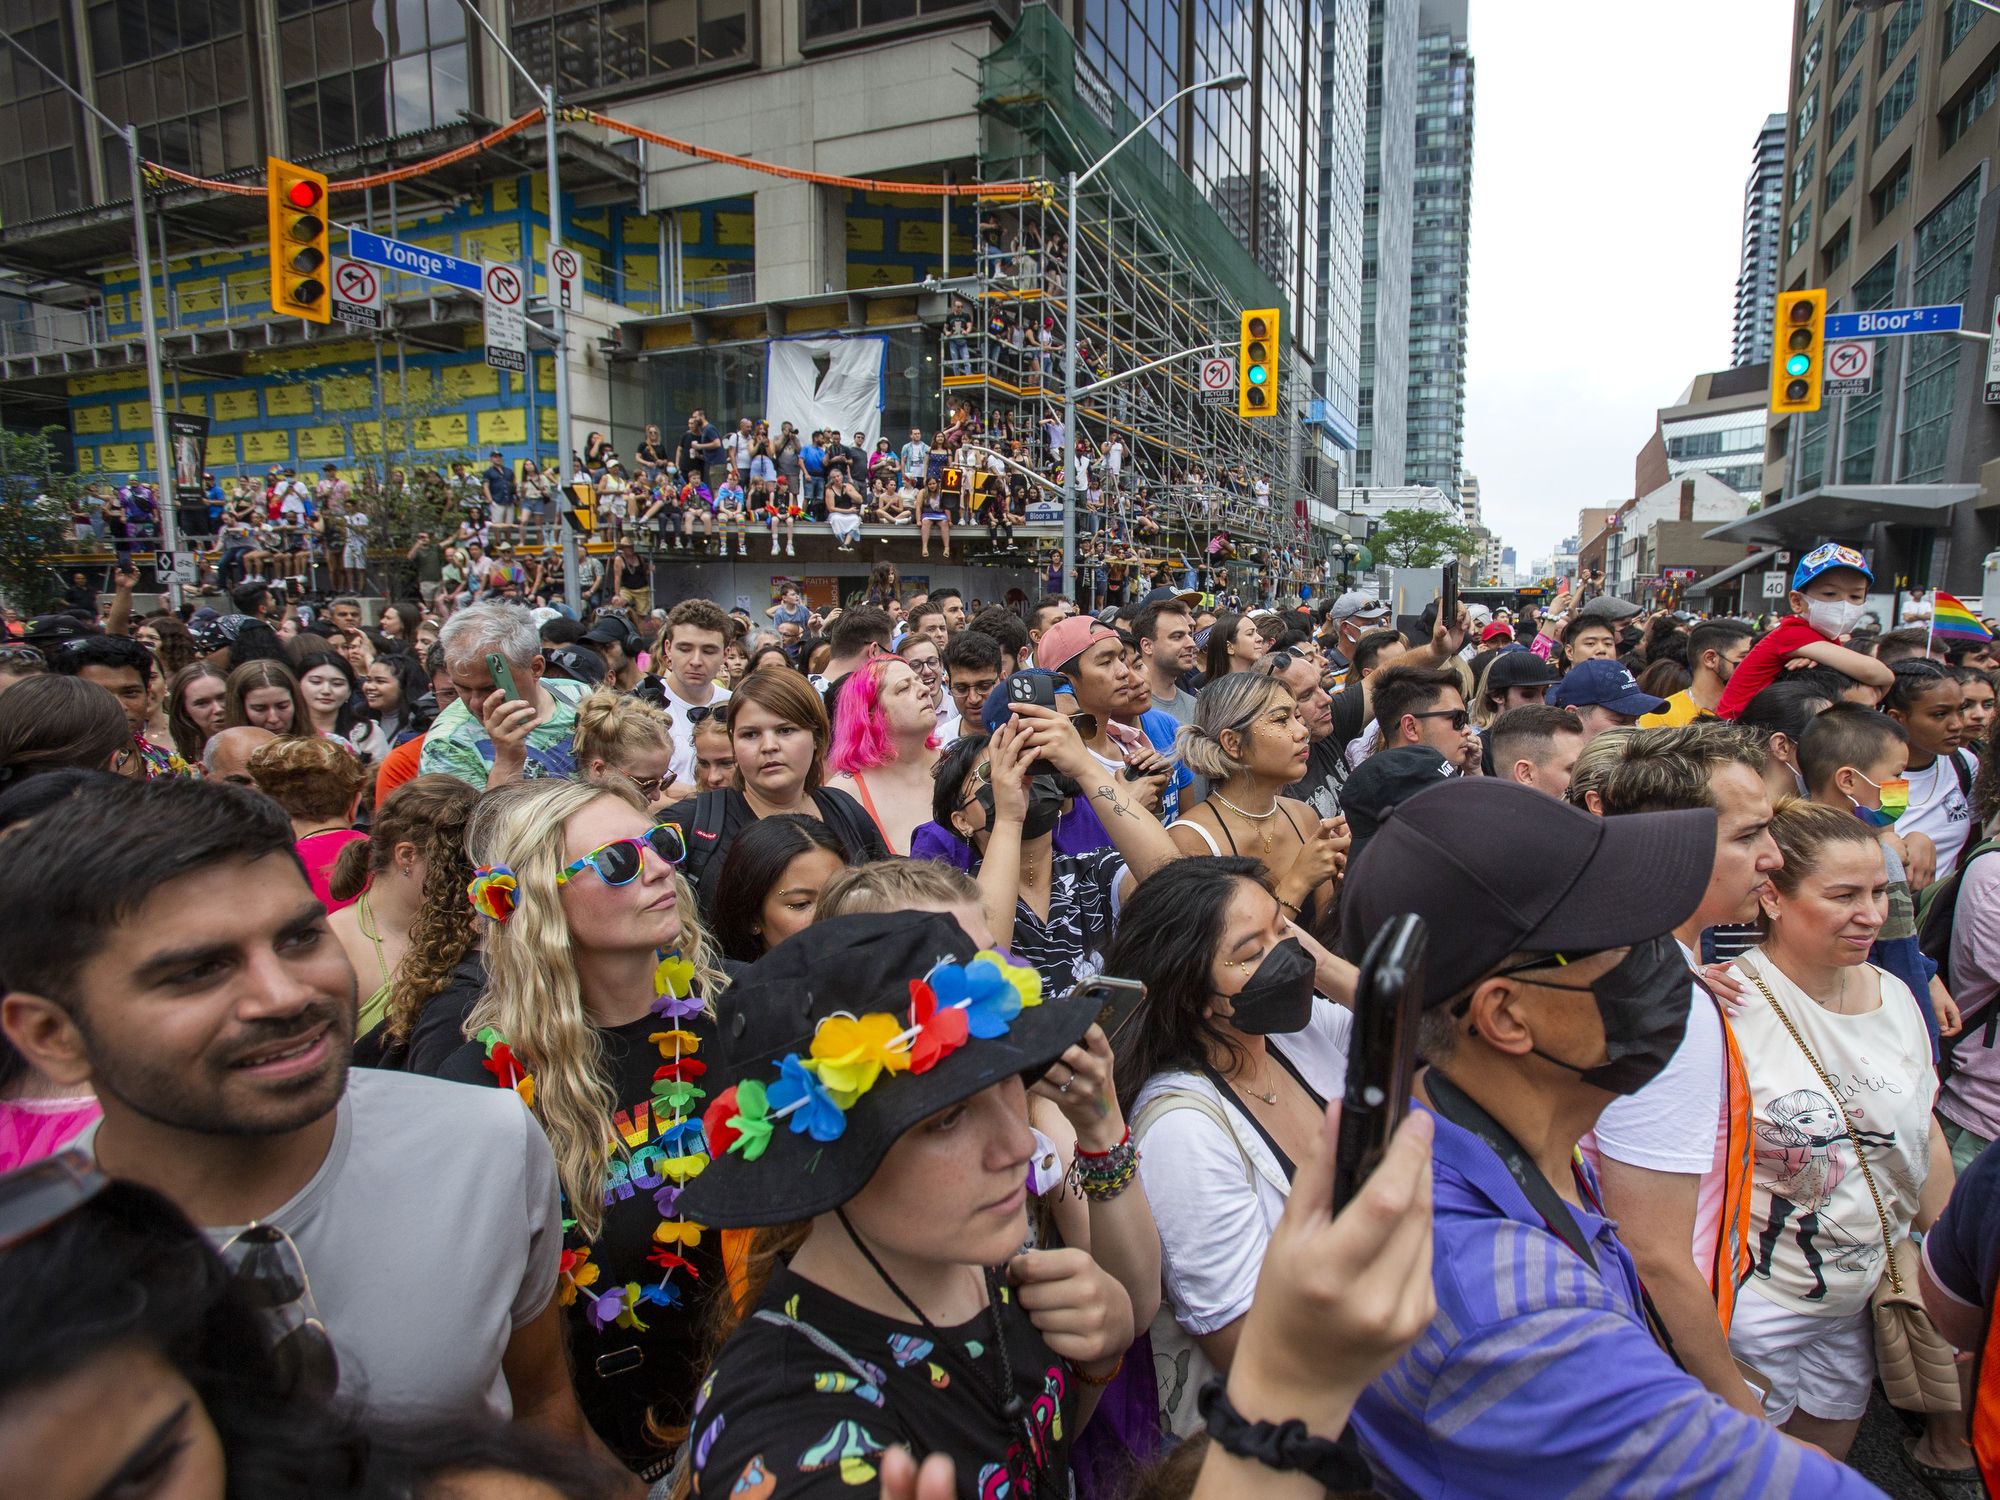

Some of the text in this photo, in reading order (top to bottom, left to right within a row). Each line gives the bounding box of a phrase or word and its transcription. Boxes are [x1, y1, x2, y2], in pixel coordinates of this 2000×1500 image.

[381, 239, 457, 274] Yonge St
[338, 301, 376, 318] BICYCLES
[337, 310, 377, 327] EXCEPTED
[1858, 311, 1924, 332] Bloor St
[489, 347, 523, 361] BICYCLES
[488, 356, 525, 370] EXCEPTED
[1828, 386, 1865, 395] EXCEPTED
[1830, 380, 1865, 388] BICYCLES
[1030, 512, 1045, 520] Bloor
[1766, 582, 1783, 594] 40
[1825, 1073, 1903, 1104] Paris
